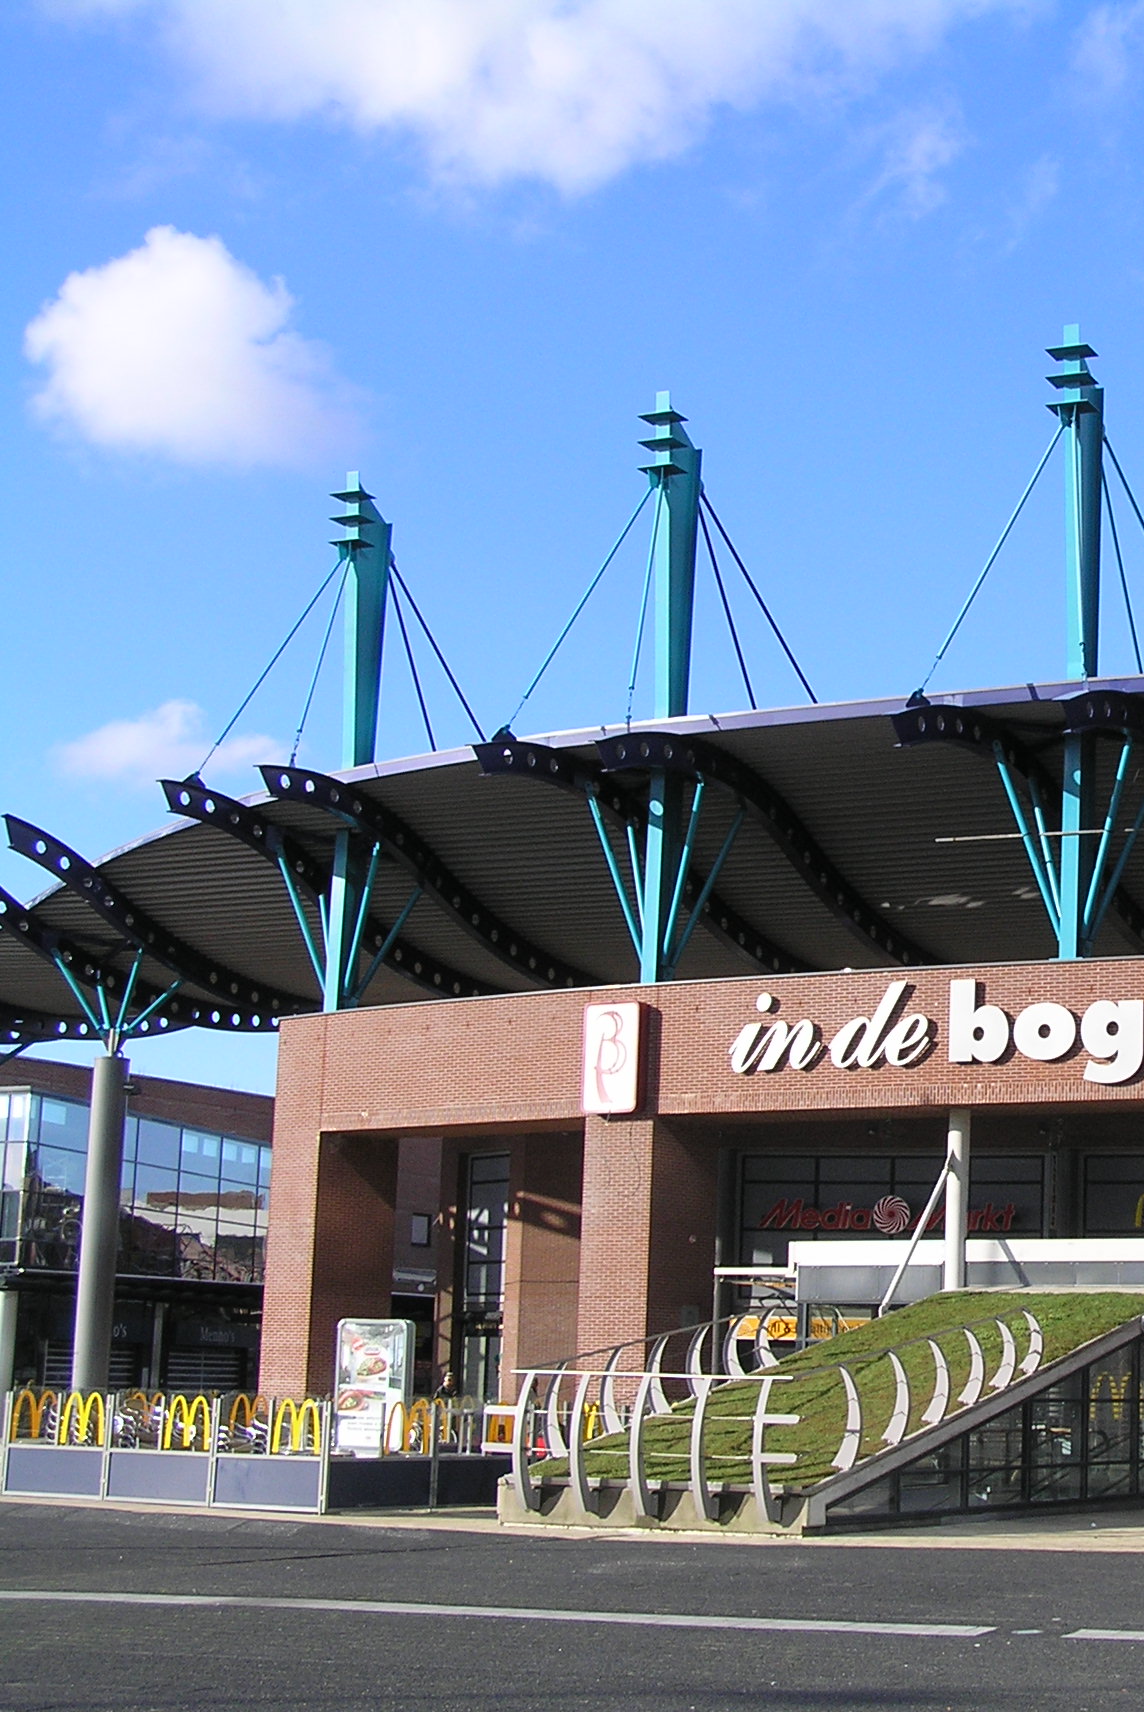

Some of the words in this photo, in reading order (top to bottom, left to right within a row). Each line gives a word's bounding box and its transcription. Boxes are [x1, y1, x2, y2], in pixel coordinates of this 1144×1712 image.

[729, 993, 823, 1074] in
[828, 980, 932, 1068] de
[757, 1198, 872, 1230] Media
[907, 1201, 1016, 1231] Mrkt
